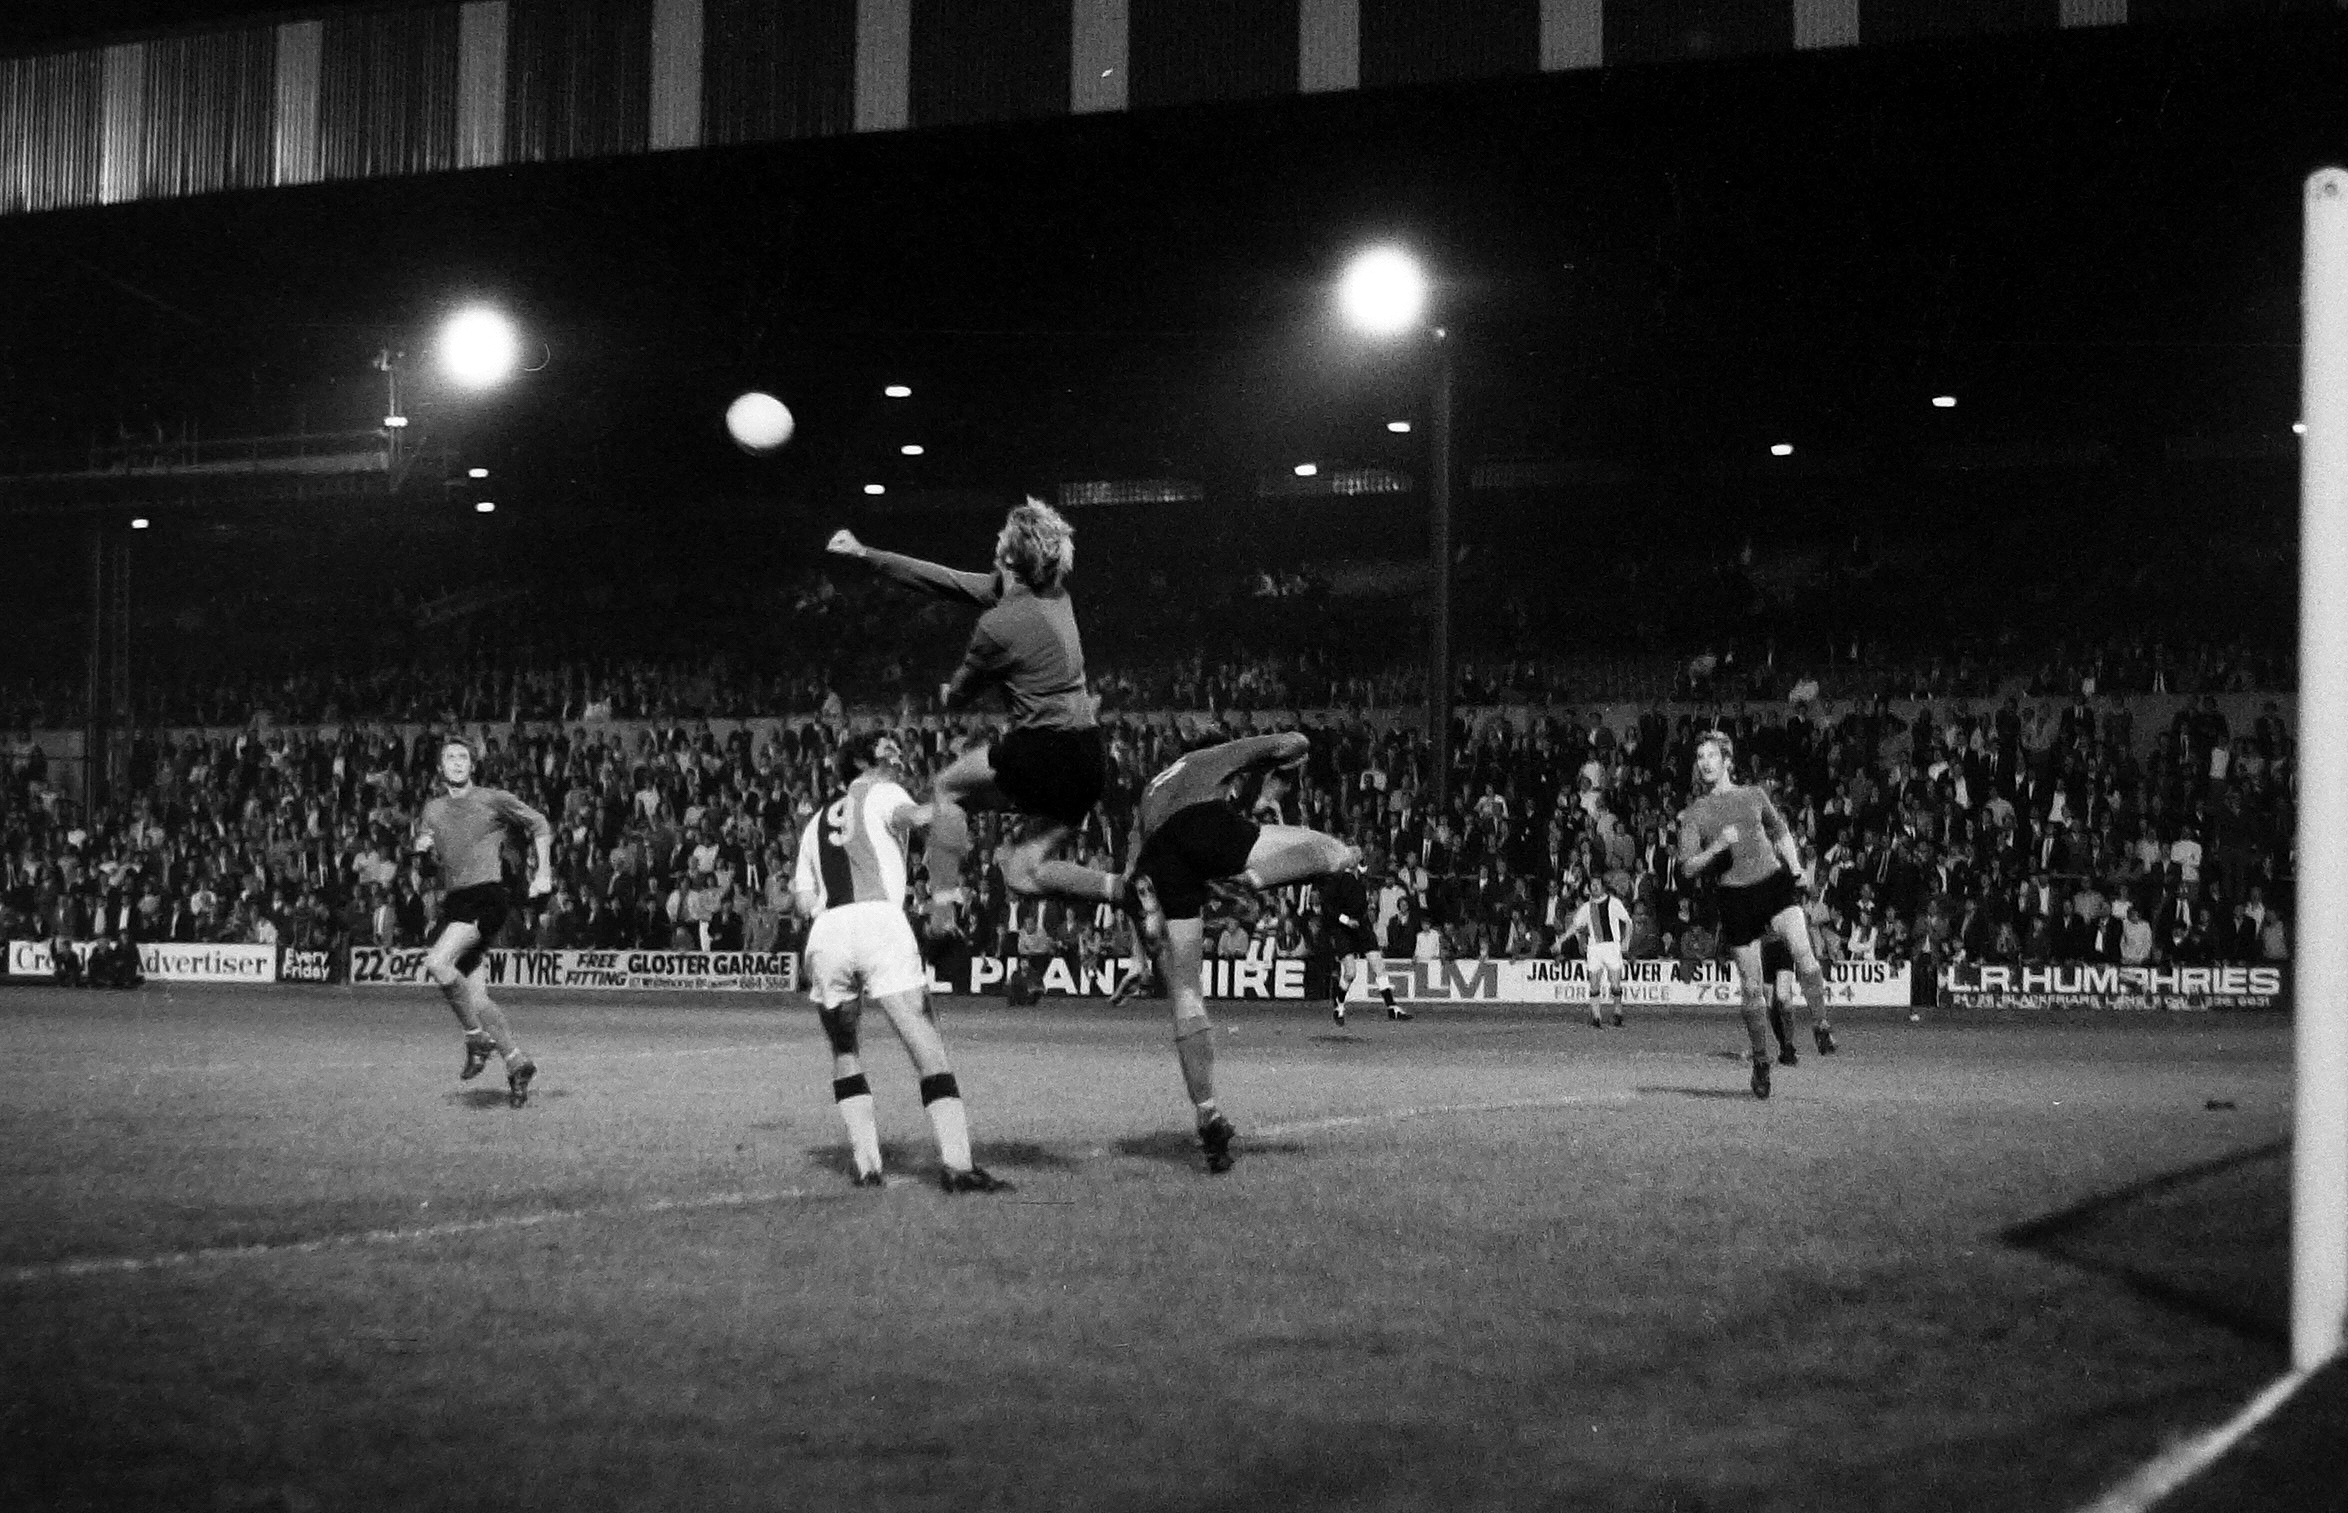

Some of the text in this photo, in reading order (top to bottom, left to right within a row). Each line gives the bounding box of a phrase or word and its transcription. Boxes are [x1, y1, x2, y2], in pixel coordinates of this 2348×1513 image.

[827, 796, 855, 846] 9
[139, 949, 268, 975] dvertiser
[512, 952, 563, 985] TYRE
[577, 953, 620, 968] FREE
[628, 954, 791, 976] GLOSTER GARAGE
[1526, 961, 1590, 982] JAGUA
[1619, 962, 1661, 982] OVER
[1670, 961, 1731, 982] ASTIN
